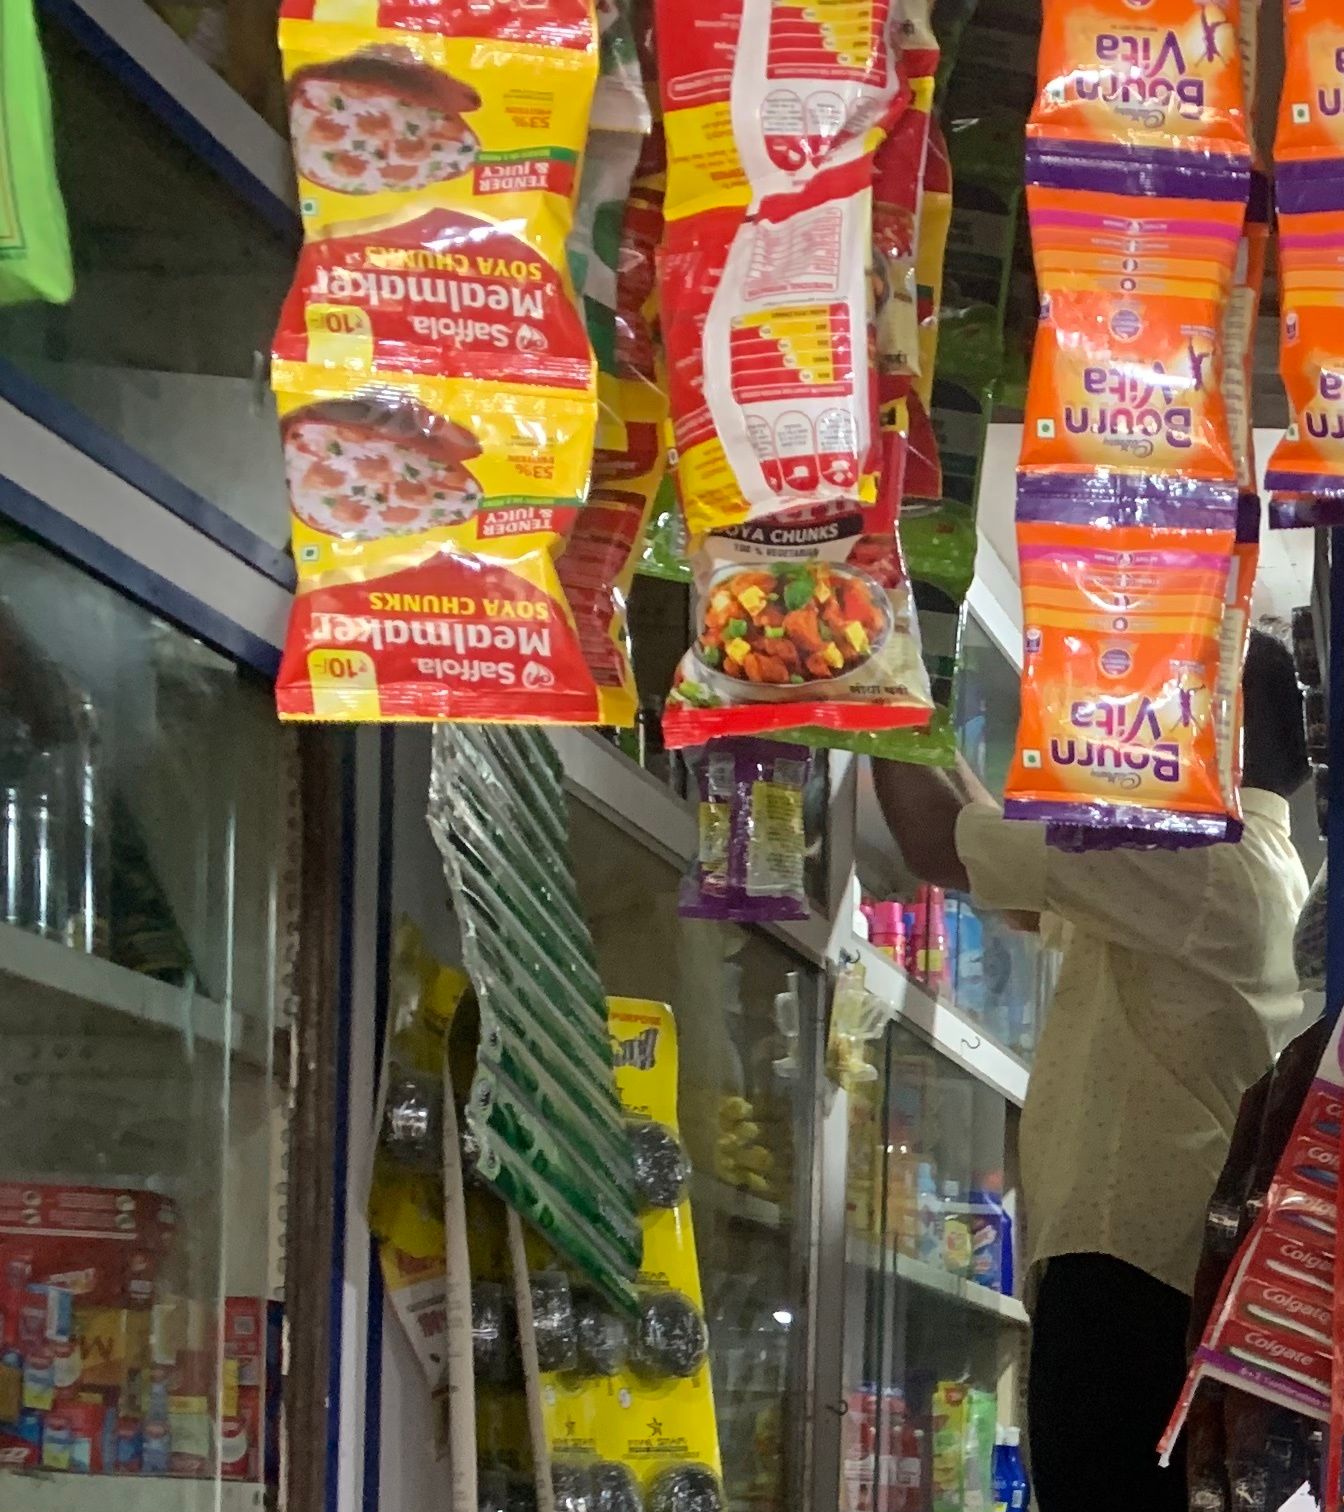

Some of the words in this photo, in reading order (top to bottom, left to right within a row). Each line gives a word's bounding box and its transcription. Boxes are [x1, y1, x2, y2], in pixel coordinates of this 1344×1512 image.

[482, 161, 532, 178] JUICY
[479, 175, 548, 193] TENDER
[476, 256, 543, 281] SOYA
[308, 266, 545, 320] Mealmaker
[412, 314, 512, 348] Saffola
[1064, 406, 1193, 449] Bourn
[481, 518, 553, 535] TENDER
[485, 506, 535, 523] JUICY
[720, 524, 764, 543] OYA
[770, 523, 839, 544] CHUNKS
[368, 591, 476, 616] CHUNKS
[481, 598, 550, 620] SOYA
[308, 611, 551, 656] Mealmaker
[414, 656, 516, 686] Saffola
[1070, 695, 1161, 743] Vita
[1050, 737, 1180, 783] Bourn
[1244, 1329, 1314, 1367] Colgate
